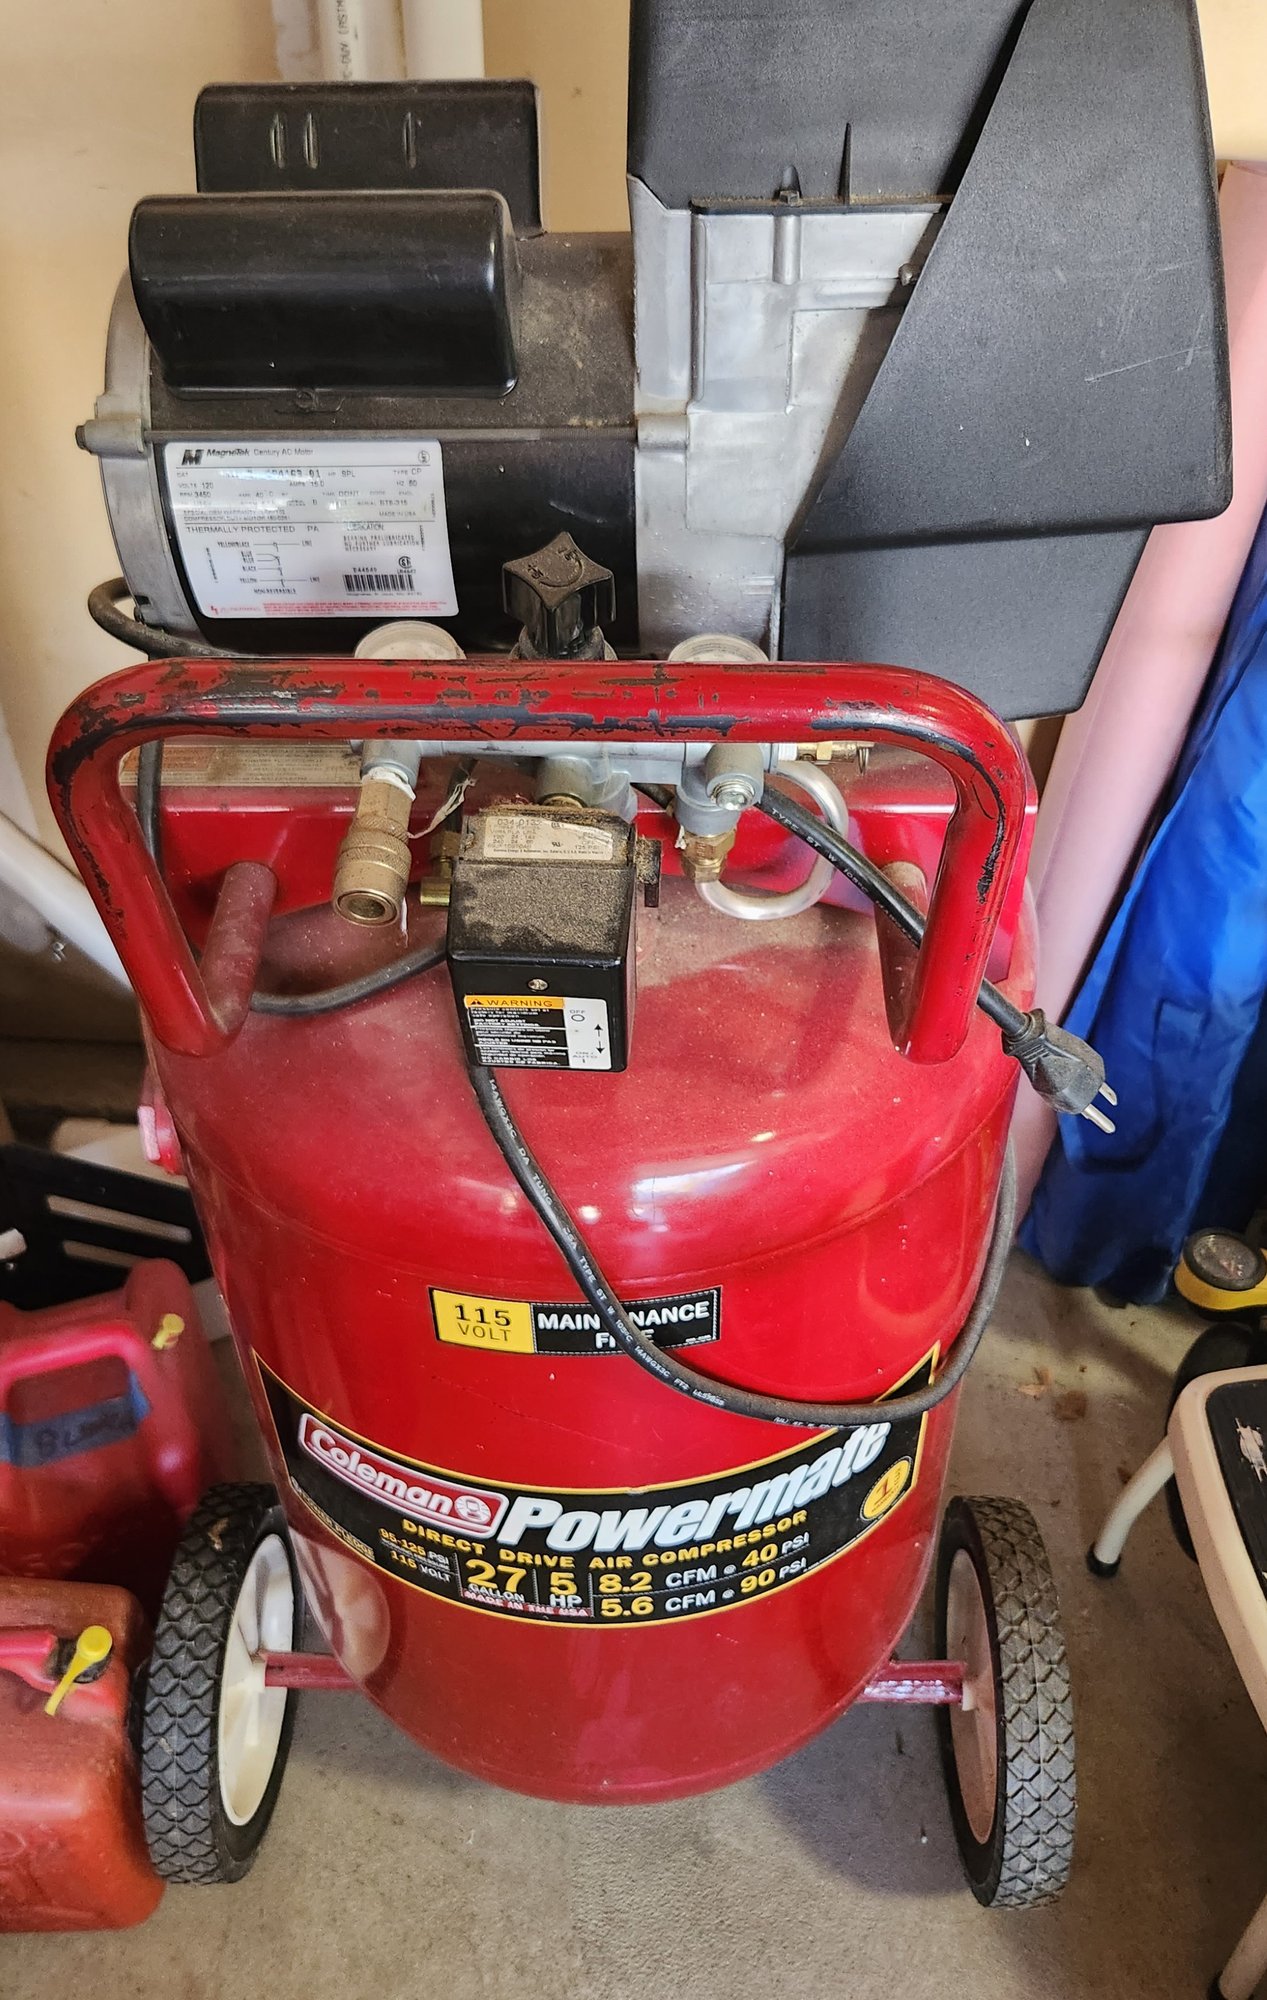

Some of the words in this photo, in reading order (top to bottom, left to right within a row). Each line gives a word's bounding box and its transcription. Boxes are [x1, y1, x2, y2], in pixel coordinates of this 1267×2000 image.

[206, 448, 250, 458] MagneTek
[253, 449, 280, 457] Century
[294, 448, 314, 456] Motor
[341, 470, 356, 478] SPL
[241, 525, 296, 533] PROTECTED
[771, 807, 800, 832] TYPE
[805, 835, 822, 850] ST
[827, 851, 838, 862] W
[518, 1147, 531, 1166] DA
[579, 1256, 597, 1283] TYPE
[596, 1288, 608, 1301] ST
[607, 1305, 616, 1316] W
[454, 1303, 512, 1327] 115
[537, 1301, 710, 1331] MAINNANCE
[457, 1321, 511, 1343] VOLT
[310, 1428, 454, 1515] Coleman
[497, 1421, 891, 1552] Powermate
[378, 1528, 427, 1557] 95-125
[427, 1550, 450, 1566] PSI
[402, 1518, 486, 1556] DIRECT
[499, 1549, 576, 1569] DRIVE
[588, 1555, 633, 1570] AIR
[642, 1510, 808, 1567] COMPRESSOR
[390, 1550, 418, 1570] 115
[420, 1563, 451, 1583] VOLT
[465, 1558, 528, 1594] 27
[598, 1571, 653, 1595] 8.2
[664, 1564, 718, 1589] CFM
[741, 1543, 780, 1568] 40
[781, 1532, 810, 1555] PSI
[468, 1583, 525, 1603] GALLON
[549, 1571, 578, 1596] 5
[600, 1596, 655, 1617] 5.6
[664, 1589, 717, 1613] CFM
[740, 1568, 776, 1595] 90
[779, 1556, 808, 1580] PSI
[463, 1591, 504, 1607] MADE
[507, 1600, 525, 1611] IN
[528, 1603, 556, 1615] THE
[559, 1607, 589, 1617] USA
[550, 1594, 583, 1608] HP
